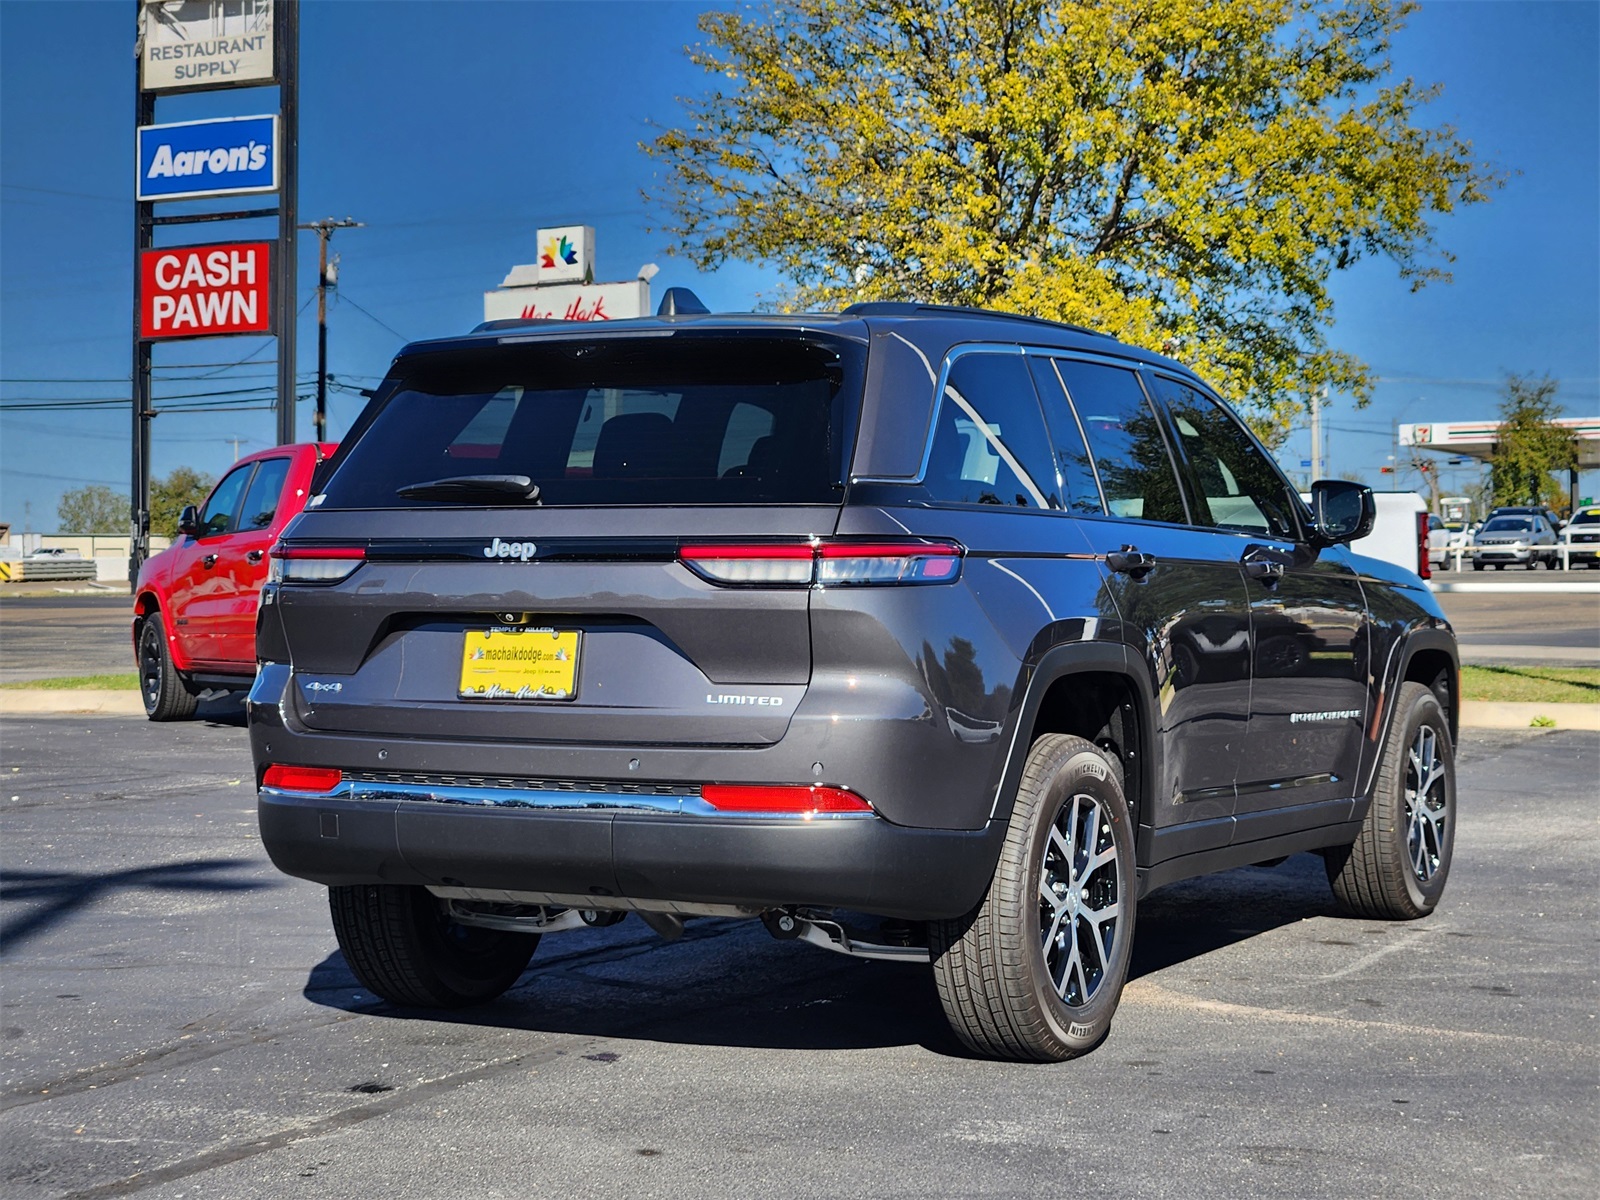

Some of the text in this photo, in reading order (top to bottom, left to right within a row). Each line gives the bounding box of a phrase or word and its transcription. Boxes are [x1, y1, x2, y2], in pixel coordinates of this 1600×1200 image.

[150, 35, 266, 61] RESTAURANT
[174, 60, 240, 80] SUPPLY
[147, 140, 267, 179] Aaron's
[154, 249, 255, 291] CASH
[153, 290, 257, 330] PAWN
[564, 296, 610, 321] Haik
[483, 537, 537, 561] Jeep
[485, 646, 554, 664] machaikdodge.com
[706, 694, 783, 706] LIMITED
[1074, 763, 1105, 779] MICHELIN
